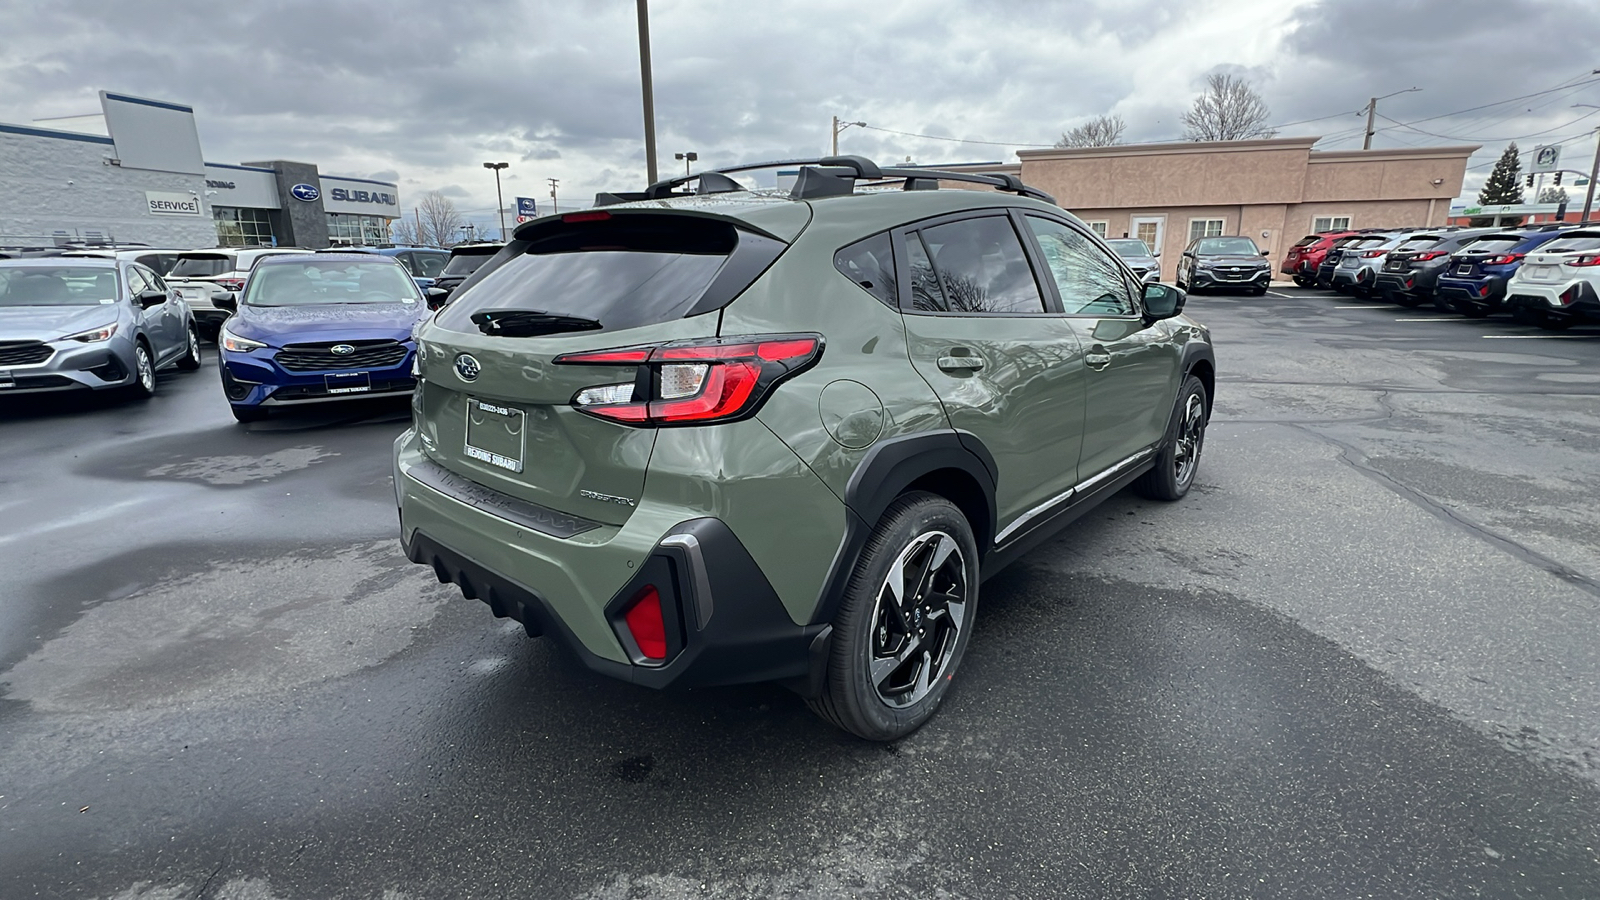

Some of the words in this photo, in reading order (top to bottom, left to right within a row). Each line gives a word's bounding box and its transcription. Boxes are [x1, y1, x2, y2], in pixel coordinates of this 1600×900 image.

[150, 200, 196, 211] SERVICE
[331, 188, 396, 206] SUBARU
[467, 447, 492, 463] REDDING
[491, 454, 517, 471] SUBARU
